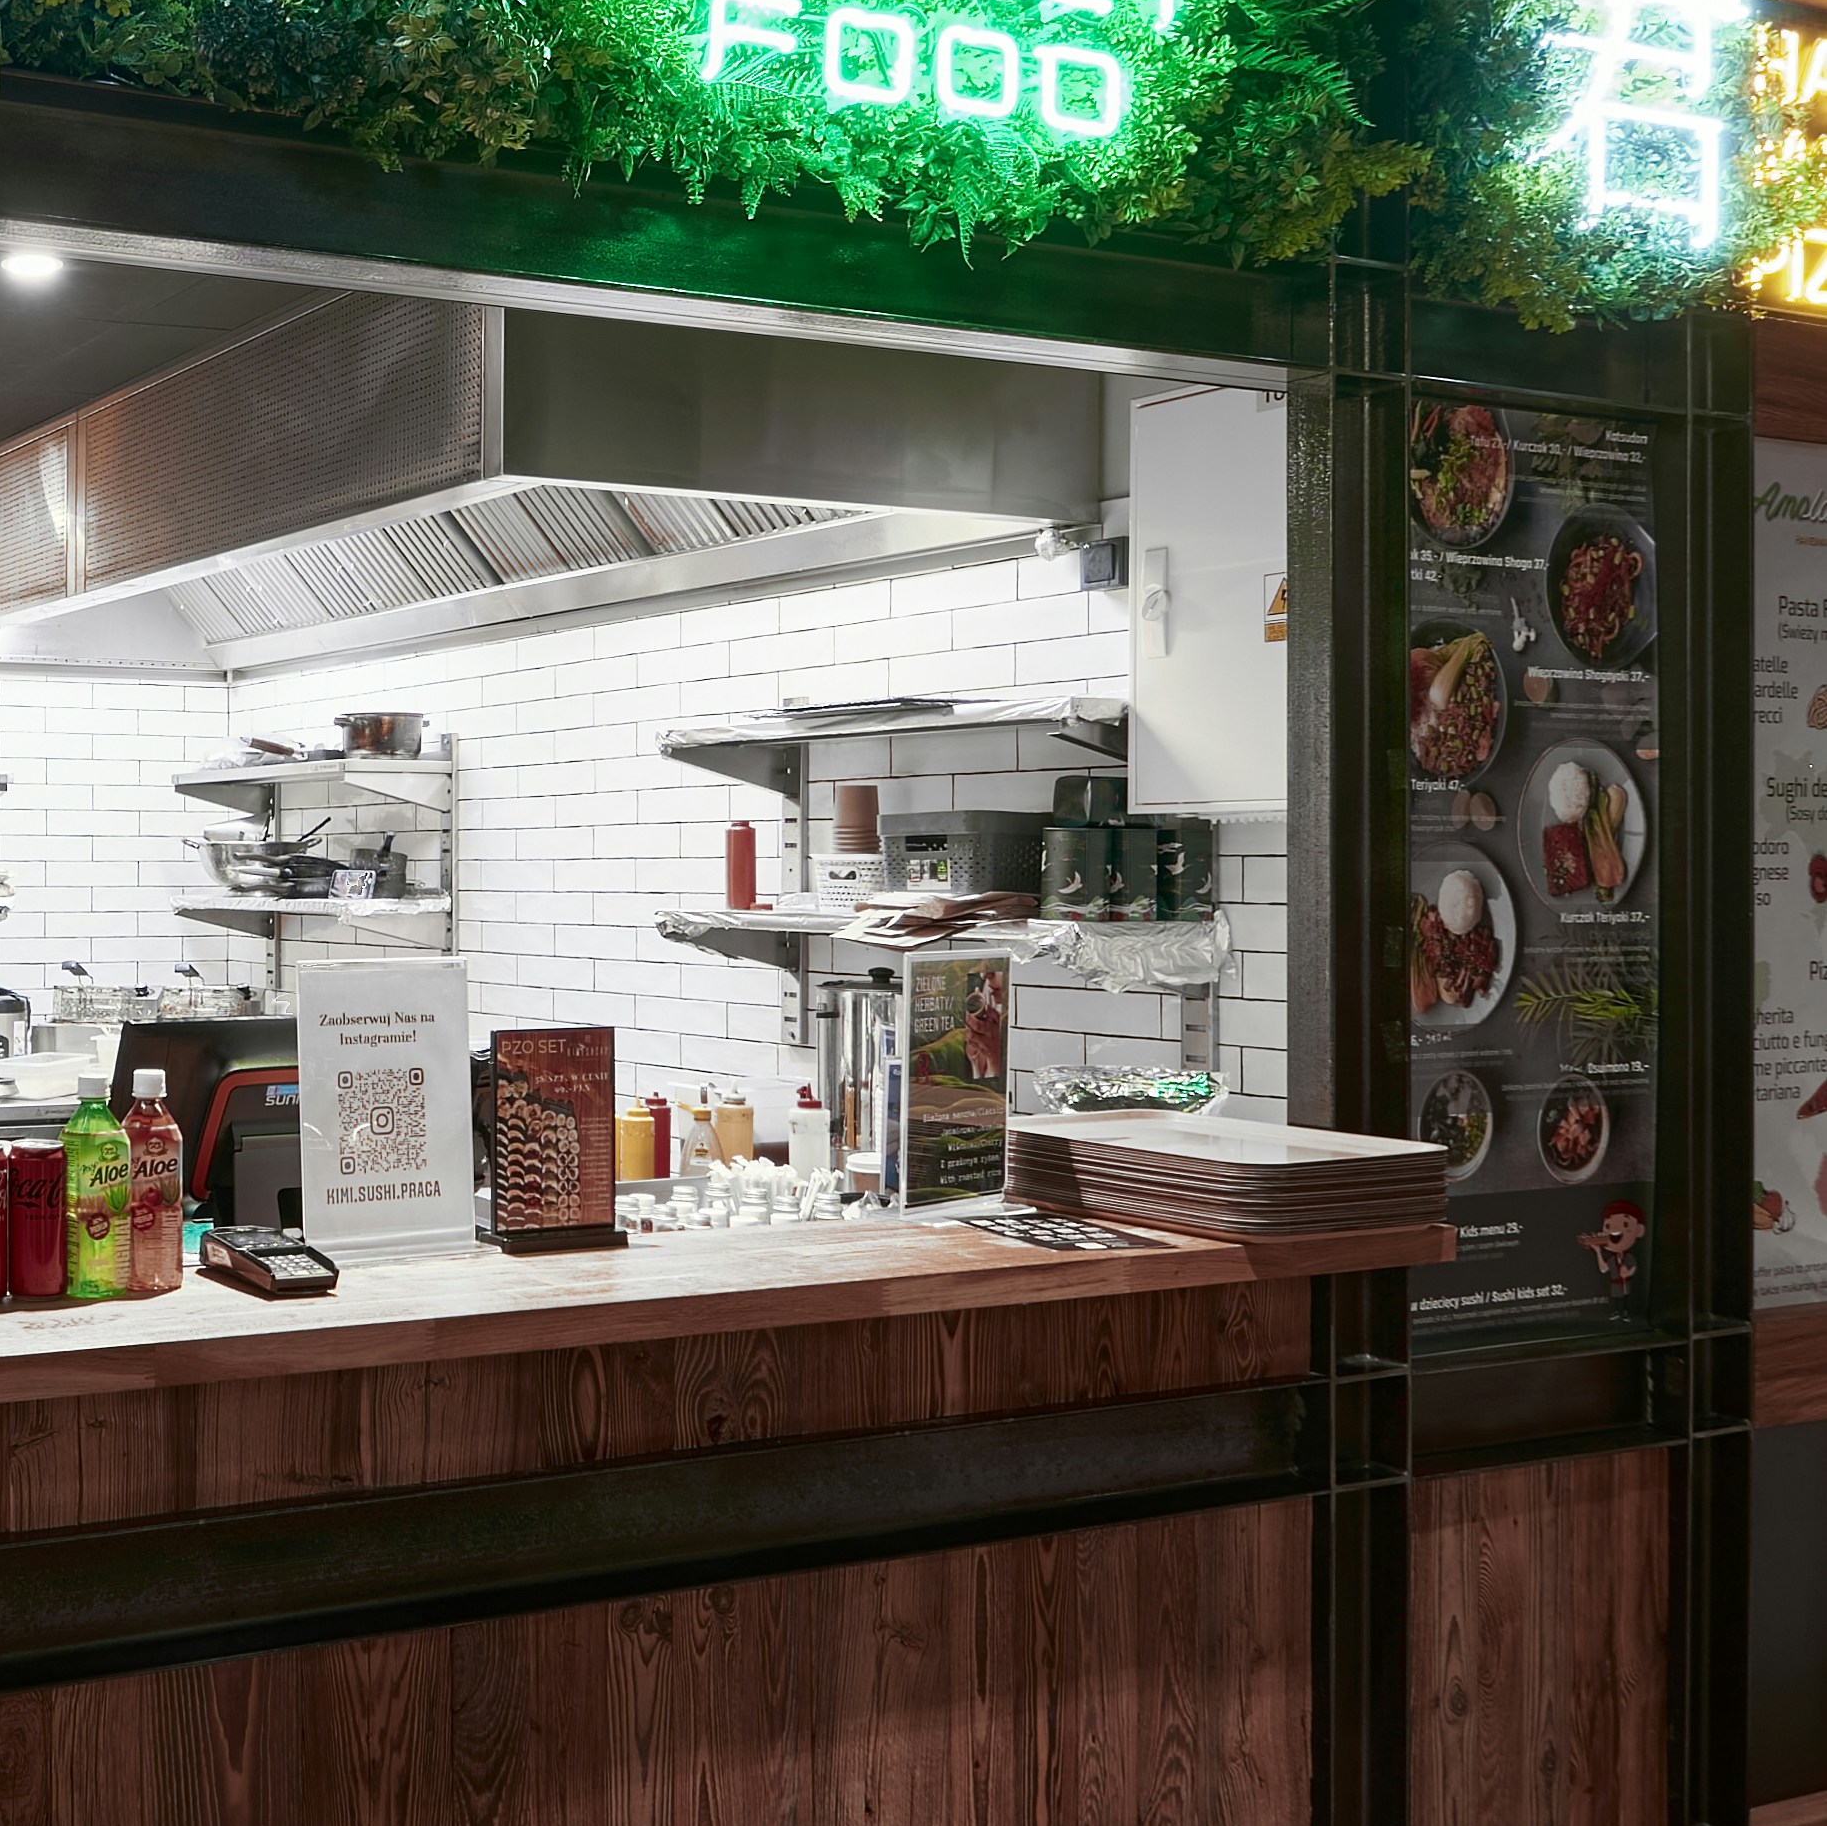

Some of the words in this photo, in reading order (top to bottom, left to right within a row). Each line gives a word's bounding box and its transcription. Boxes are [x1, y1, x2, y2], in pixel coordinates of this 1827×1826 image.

[1778, 595, 1819, 619] Pasta
[1766, 776, 1808, 804] Sughi
[915, 974, 947, 992] ZIELONE
[319, 1011, 391, 1028] Zaobserwuj
[395, 1010, 417, 1024] Nas
[420, 1012, 435, 1024] na
[914, 1018, 938, 1033] GREEN
[940, 1015, 955, 1032] TEA
[339, 1029, 417, 1048] Instagramie!
[501, 1039, 534, 1055] PZO
[537, 1038, 568, 1054] SET
[89, 1161, 129, 1188] Aloe
[132, 1157, 179, 1181] Aloe
[326, 1179, 442, 1206] KIMI.SUSHI.PRACA
